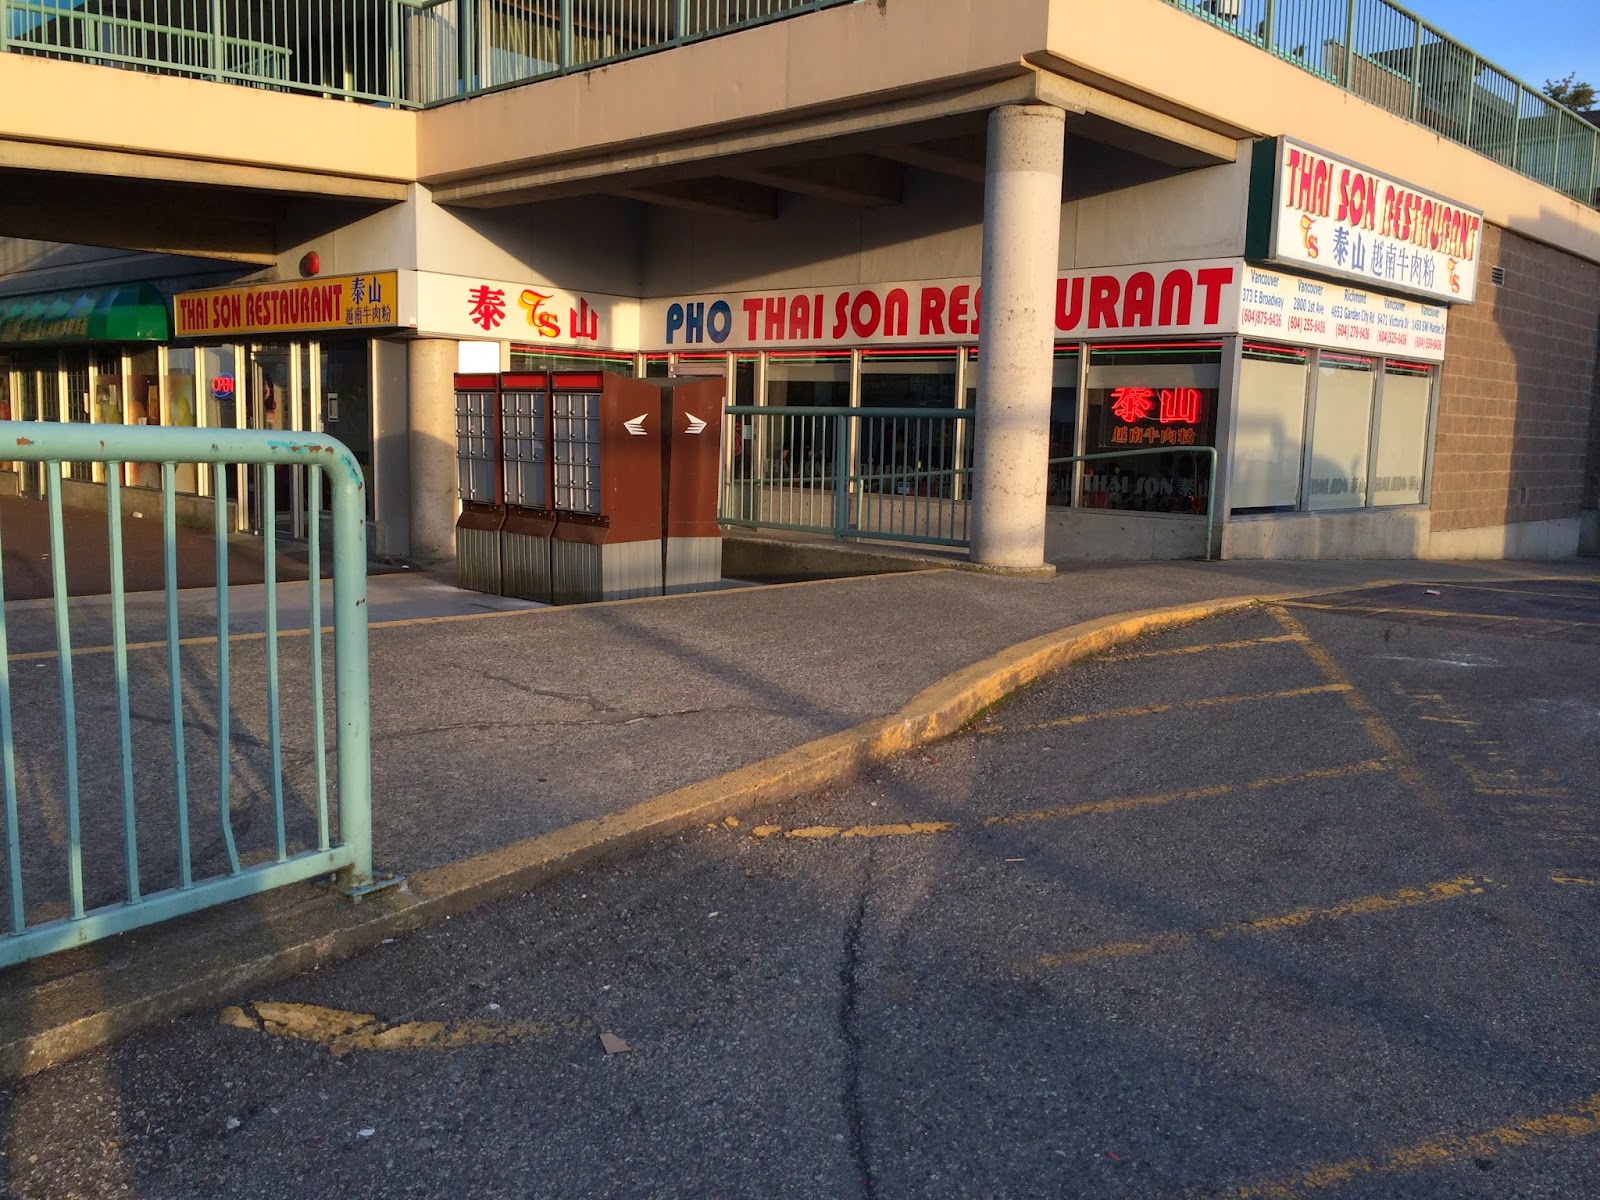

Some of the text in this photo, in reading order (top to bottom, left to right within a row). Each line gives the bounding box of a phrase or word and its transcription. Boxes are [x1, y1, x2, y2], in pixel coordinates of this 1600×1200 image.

[1286, 148, 1480, 261] THAI SON RESTAURANT
[1333, 226, 1436, 289] 泰山 越南牛肉粉
[1251, 269, 1279, 287] Vancouver
[1297, 278, 1323, 296] Vancouver
[351, 276, 382, 305] 泰山
[1242, 288, 1253, 302] 373
[1259, 291, 1284, 311] Broadway
[1344, 289, 1367, 304] Richmond
[180, 284, 343, 330] THAI SON RESTAURANT
[467, 285, 599, 340] 泰 山
[666, 267, 1234, 344] PHO THAI SON REURANT
[1293, 297, 1306, 312] 2800
[1316, 302, 1324, 315] Ave
[1384, 297, 1406, 312] Vancouver
[1421, 304, 1440, 318] Vancouver
[345, 304, 392, 325] 越南牛肉粉
[1331, 305, 1375, 326] 4653 Garden City Rd
[1389, 314, 1404, 328] Victoria
[1288, 315, 1303, 333] (604)
[1336, 323, 1349, 340] (604)
[212, 377, 234, 393] OPEN
[1111, 388, 1198, 423] 泰山
[1111, 426, 1196, 444] 越南牛肉粉
